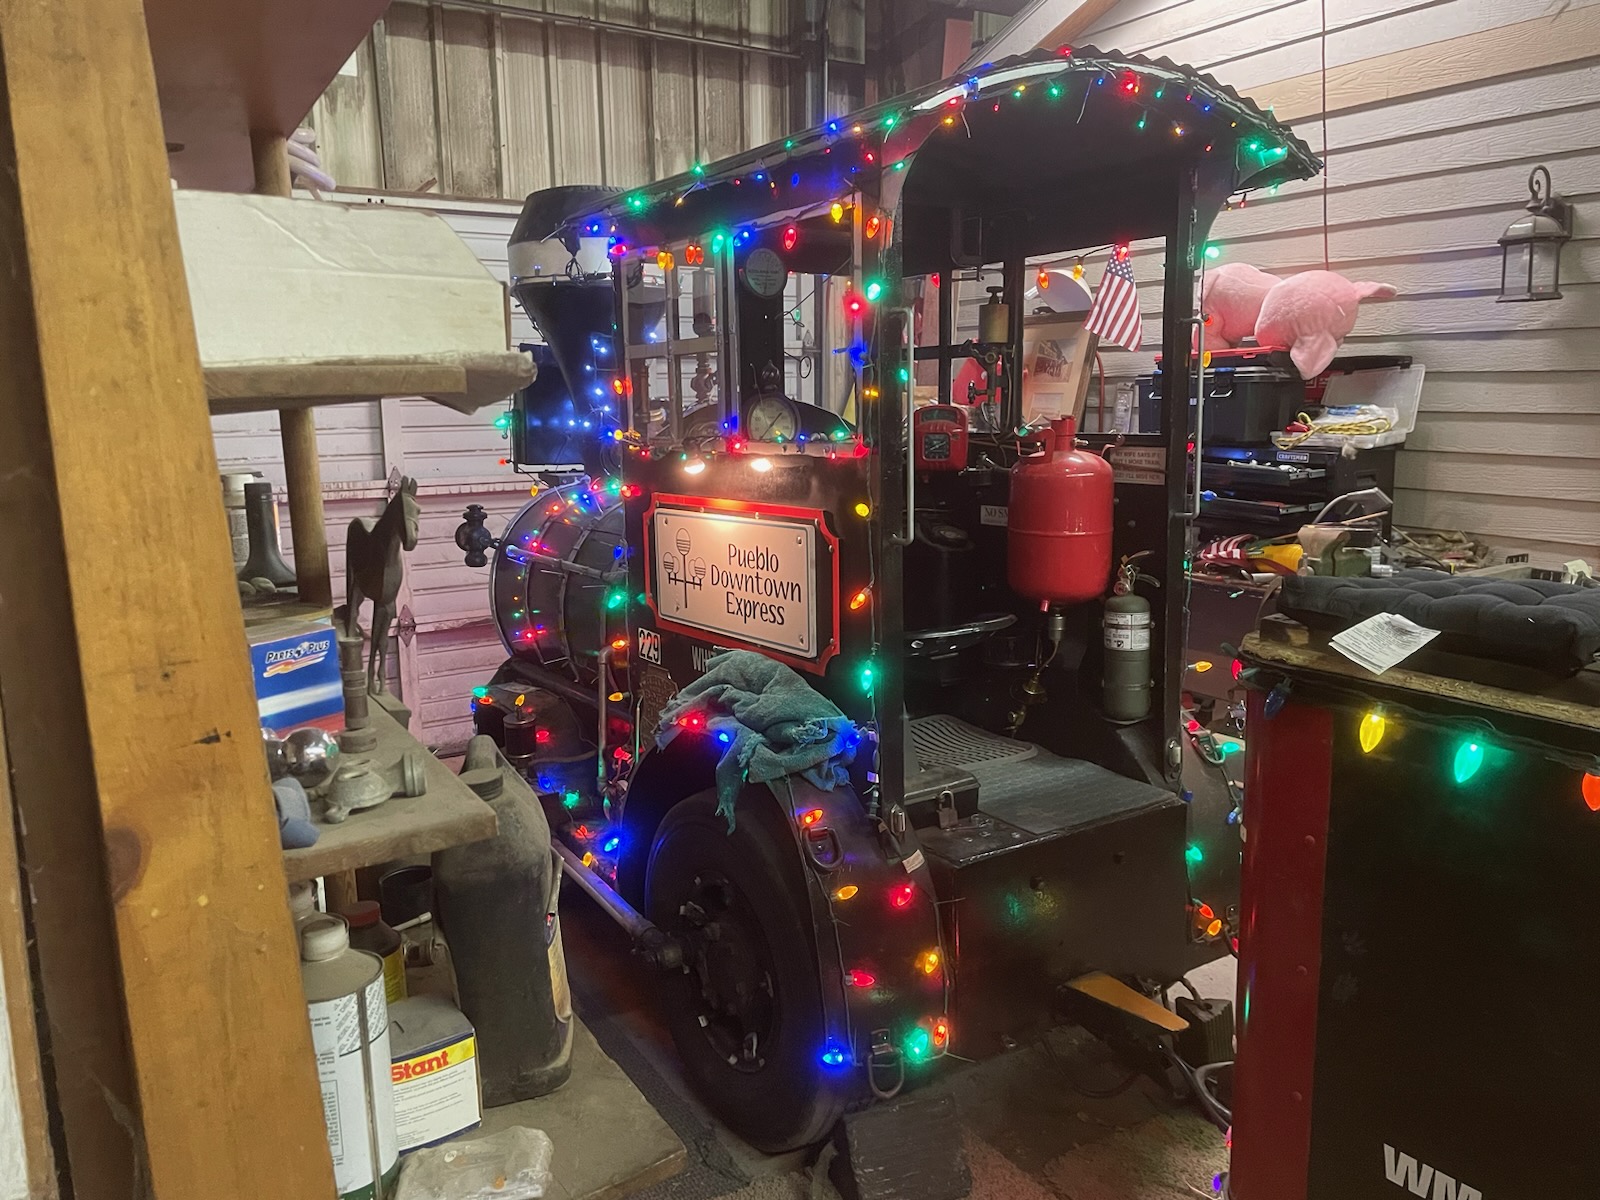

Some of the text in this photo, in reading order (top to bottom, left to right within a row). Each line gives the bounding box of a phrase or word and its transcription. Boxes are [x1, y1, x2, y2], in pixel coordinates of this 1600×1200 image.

[1278, 453, 1307, 461] CRAFTSMAN
[984, 506, 997, 518] NO
[728, 543, 779, 573] Pueblo
[711, 564, 802, 603] Downtown
[726, 591, 785, 625] Express
[266, 641, 330, 664] PARTS PLUS
[640, 630, 659, 662] 229
[392, 1050, 449, 1083] Stant
